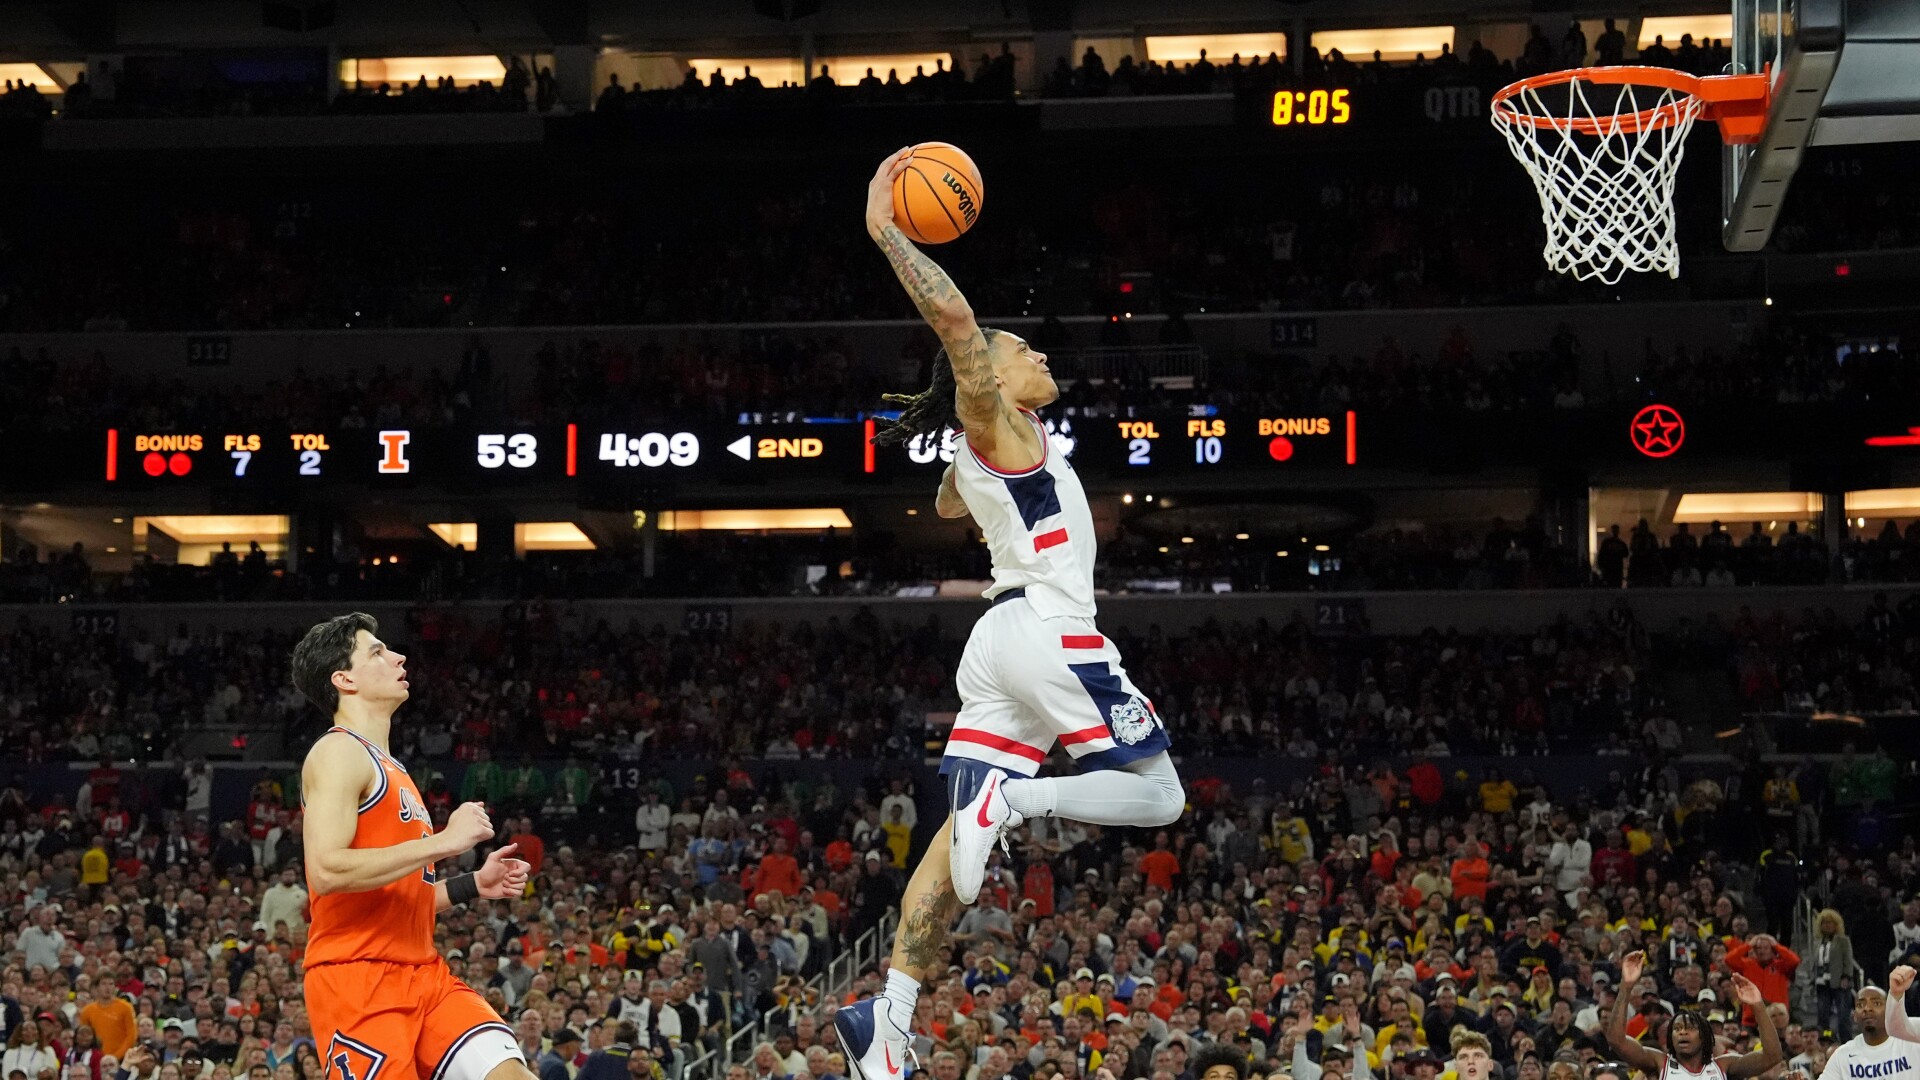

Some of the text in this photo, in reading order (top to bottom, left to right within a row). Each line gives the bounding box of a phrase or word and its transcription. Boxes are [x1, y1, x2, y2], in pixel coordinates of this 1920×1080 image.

[1272, 88, 1350, 126] 8:05
[1424, 86, 1480, 121] QTR
[942, 171, 977, 228] Wilson
[191, 342, 228, 360] 312
[1118, 421, 1160, 438] TOL
[1187, 419, 1226, 438] FLS
[1258, 418, 1331, 436] BONUS
[135, 434, 203, 451] BONUS
[224, 435, 261, 451] FLS
[290, 434, 330, 451] TOL
[477, 433, 538, 469] 53
[599, 432, 700, 467] 4:09
[757, 438, 823, 458] 2ND
[1128, 438, 1151, 465] 2
[1195, 437, 1222, 464] 10
[231, 451, 252, 476] 7
[299, 450, 322, 476] 2
[1849, 1056, 1912, 1079] LOCK IT IN.
